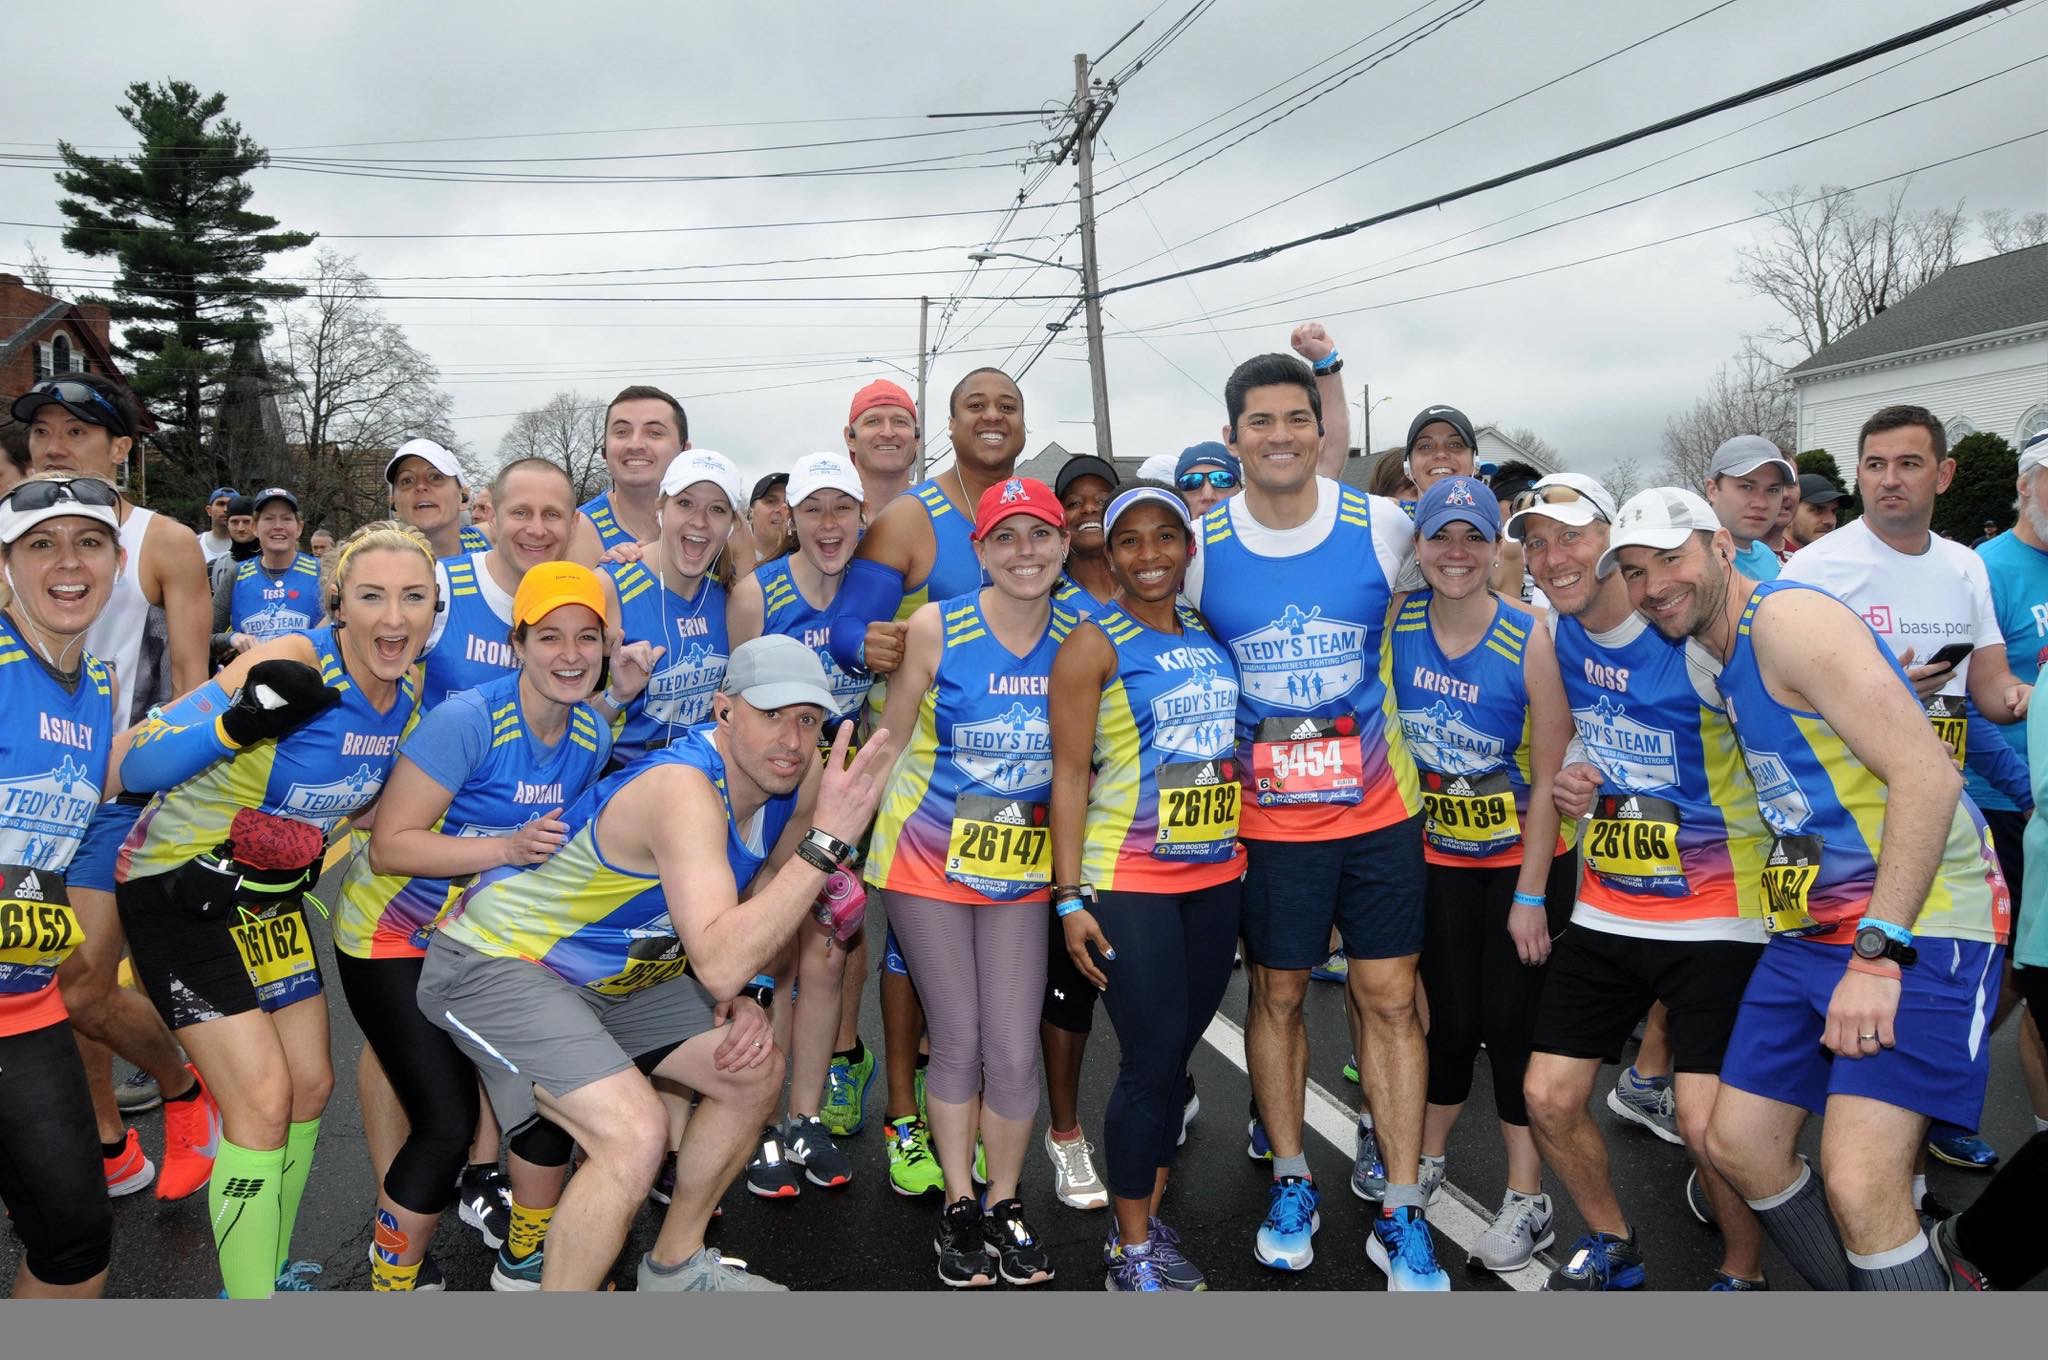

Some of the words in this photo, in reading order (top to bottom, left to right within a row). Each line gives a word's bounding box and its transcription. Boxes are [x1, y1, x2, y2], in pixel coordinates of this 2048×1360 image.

[262, 588, 285, 600] TESS
[277, 617, 304, 628] TEAM
[676, 616, 708, 638] ERIN
[2031, 602, 2048, 638] R
[1240, 637, 1303, 661] TEDY'S
[1307, 630, 1356, 655] TEAM
[1154, 646, 1224, 672] KRISTI
[1267, 661, 1309, 671] AWARENESS
[1309, 657, 1340, 668] FIGHTING
[657, 669, 700, 692] TEDY'S
[988, 672, 1049, 696] LAUREN
[1412, 665, 1479, 705] KRISTEN
[1584, 657, 1630, 693] ROSS
[1163, 692, 1211, 717] TEDY'S
[39, 711, 93, 751] ASHLEY
[964, 730, 1021, 750] TEDY'S
[1290, 731, 1323, 740] adidas
[1402, 718, 1444, 740] EDY'S
[1448, 730, 1492, 754] TEAM
[1615, 729, 1662, 754] TEAM
[341, 731, 400, 756] BRIDGET
[1270, 740, 1344, 779] 5454
[512, 780, 565, 804] ABIGAIL
[1260, 779, 1269, 789] 6
[1447, 787, 1475, 797] adidas
[4, 787, 65, 819] TEDY'S
[302, 791, 355, 810] TEDY'S
[1167, 785, 1236, 827] 26132
[1423, 795, 1507, 829] 26139
[993, 815, 1026, 825] adidas
[1428, 821, 1436, 830] 3
[1617, 811, 1643, 819] adidas
[958, 822, 1046, 865] 26147
[1160, 829, 1169, 839] 3
[1590, 821, 1670, 860] 26166
[950, 858, 960, 869] 3
[1588, 858, 1597, 868] 3
[14, 888, 44, 901] adidas
[980, 878, 1008, 888] BOSTON
[1766, 916, 1775, 929] 3
[236, 916, 305, 968] 26162
